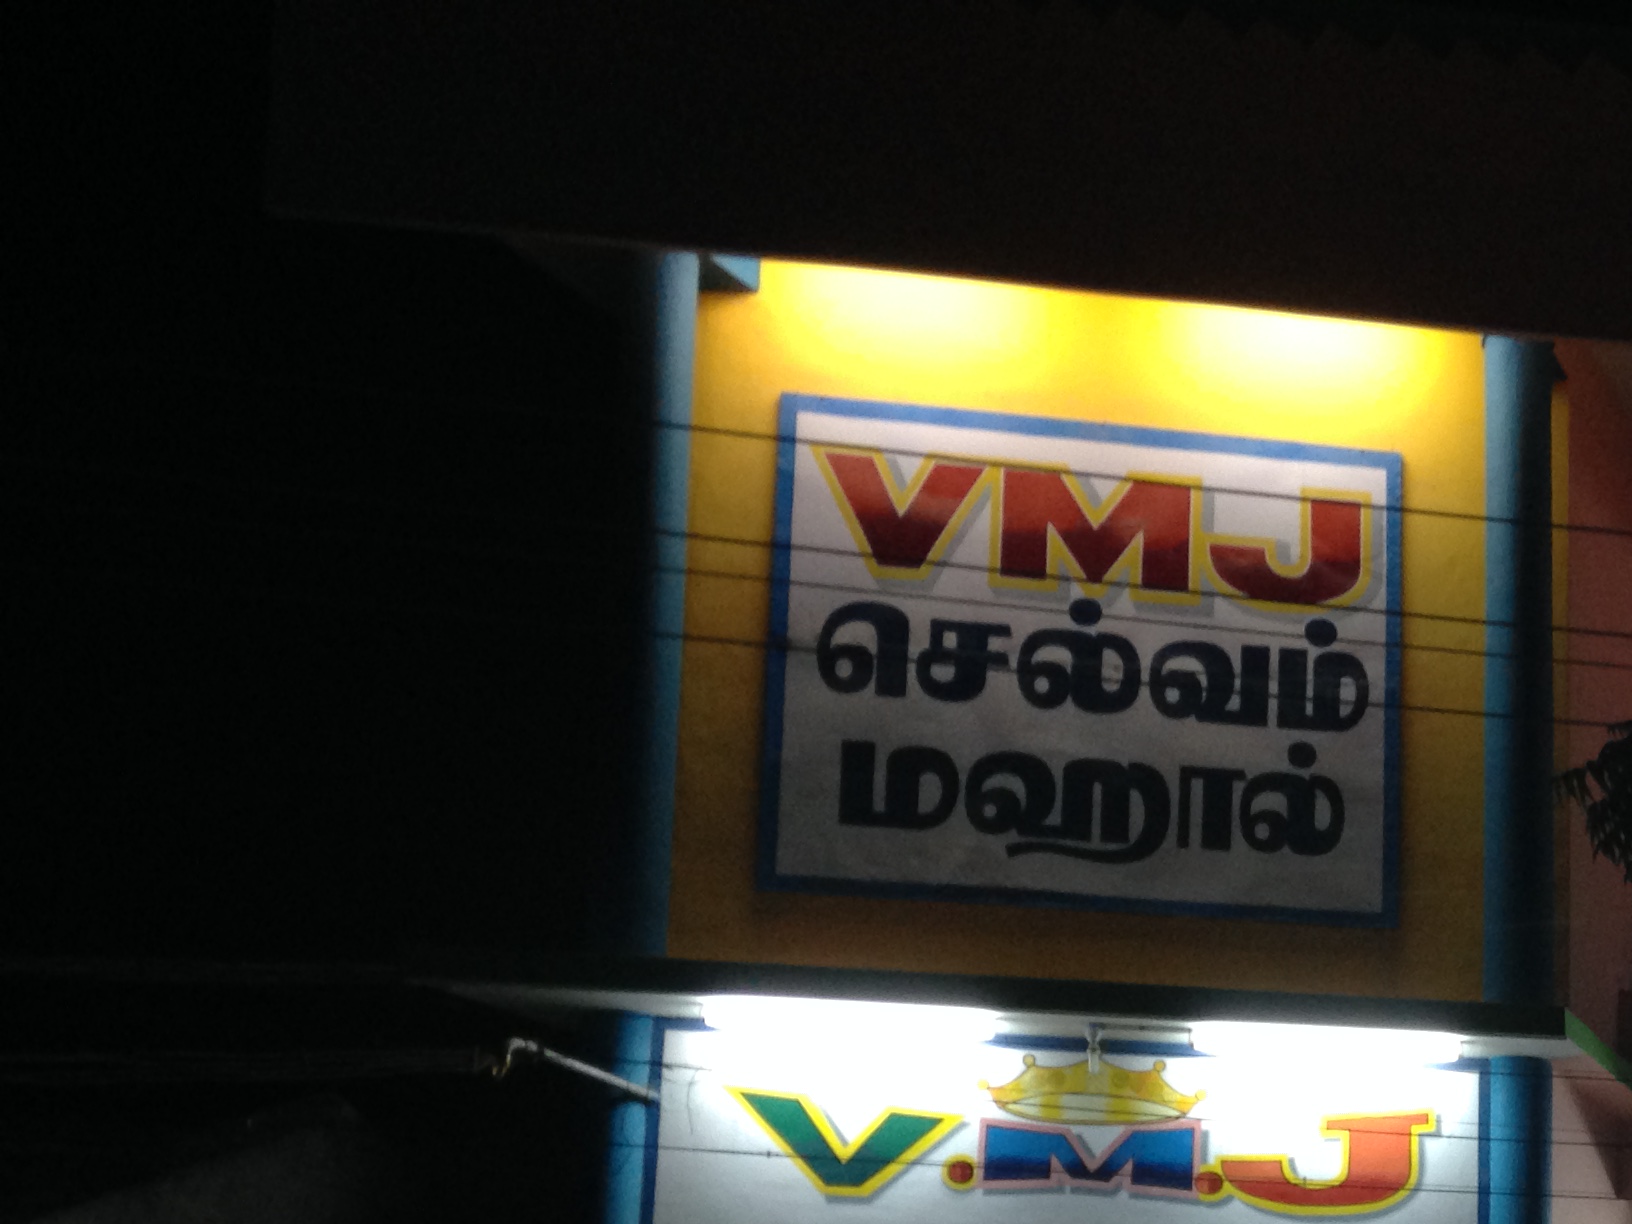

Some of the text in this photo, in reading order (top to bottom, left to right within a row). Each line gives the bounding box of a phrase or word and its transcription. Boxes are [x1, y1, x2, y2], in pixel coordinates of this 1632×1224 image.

[816, 446, 1372, 606] VMJ
[817, 598, 1370, 733] செல்வம்
[838, 742, 1345, 864] மஹால்
[727, 1086, 1438, 1216] V.M.J
